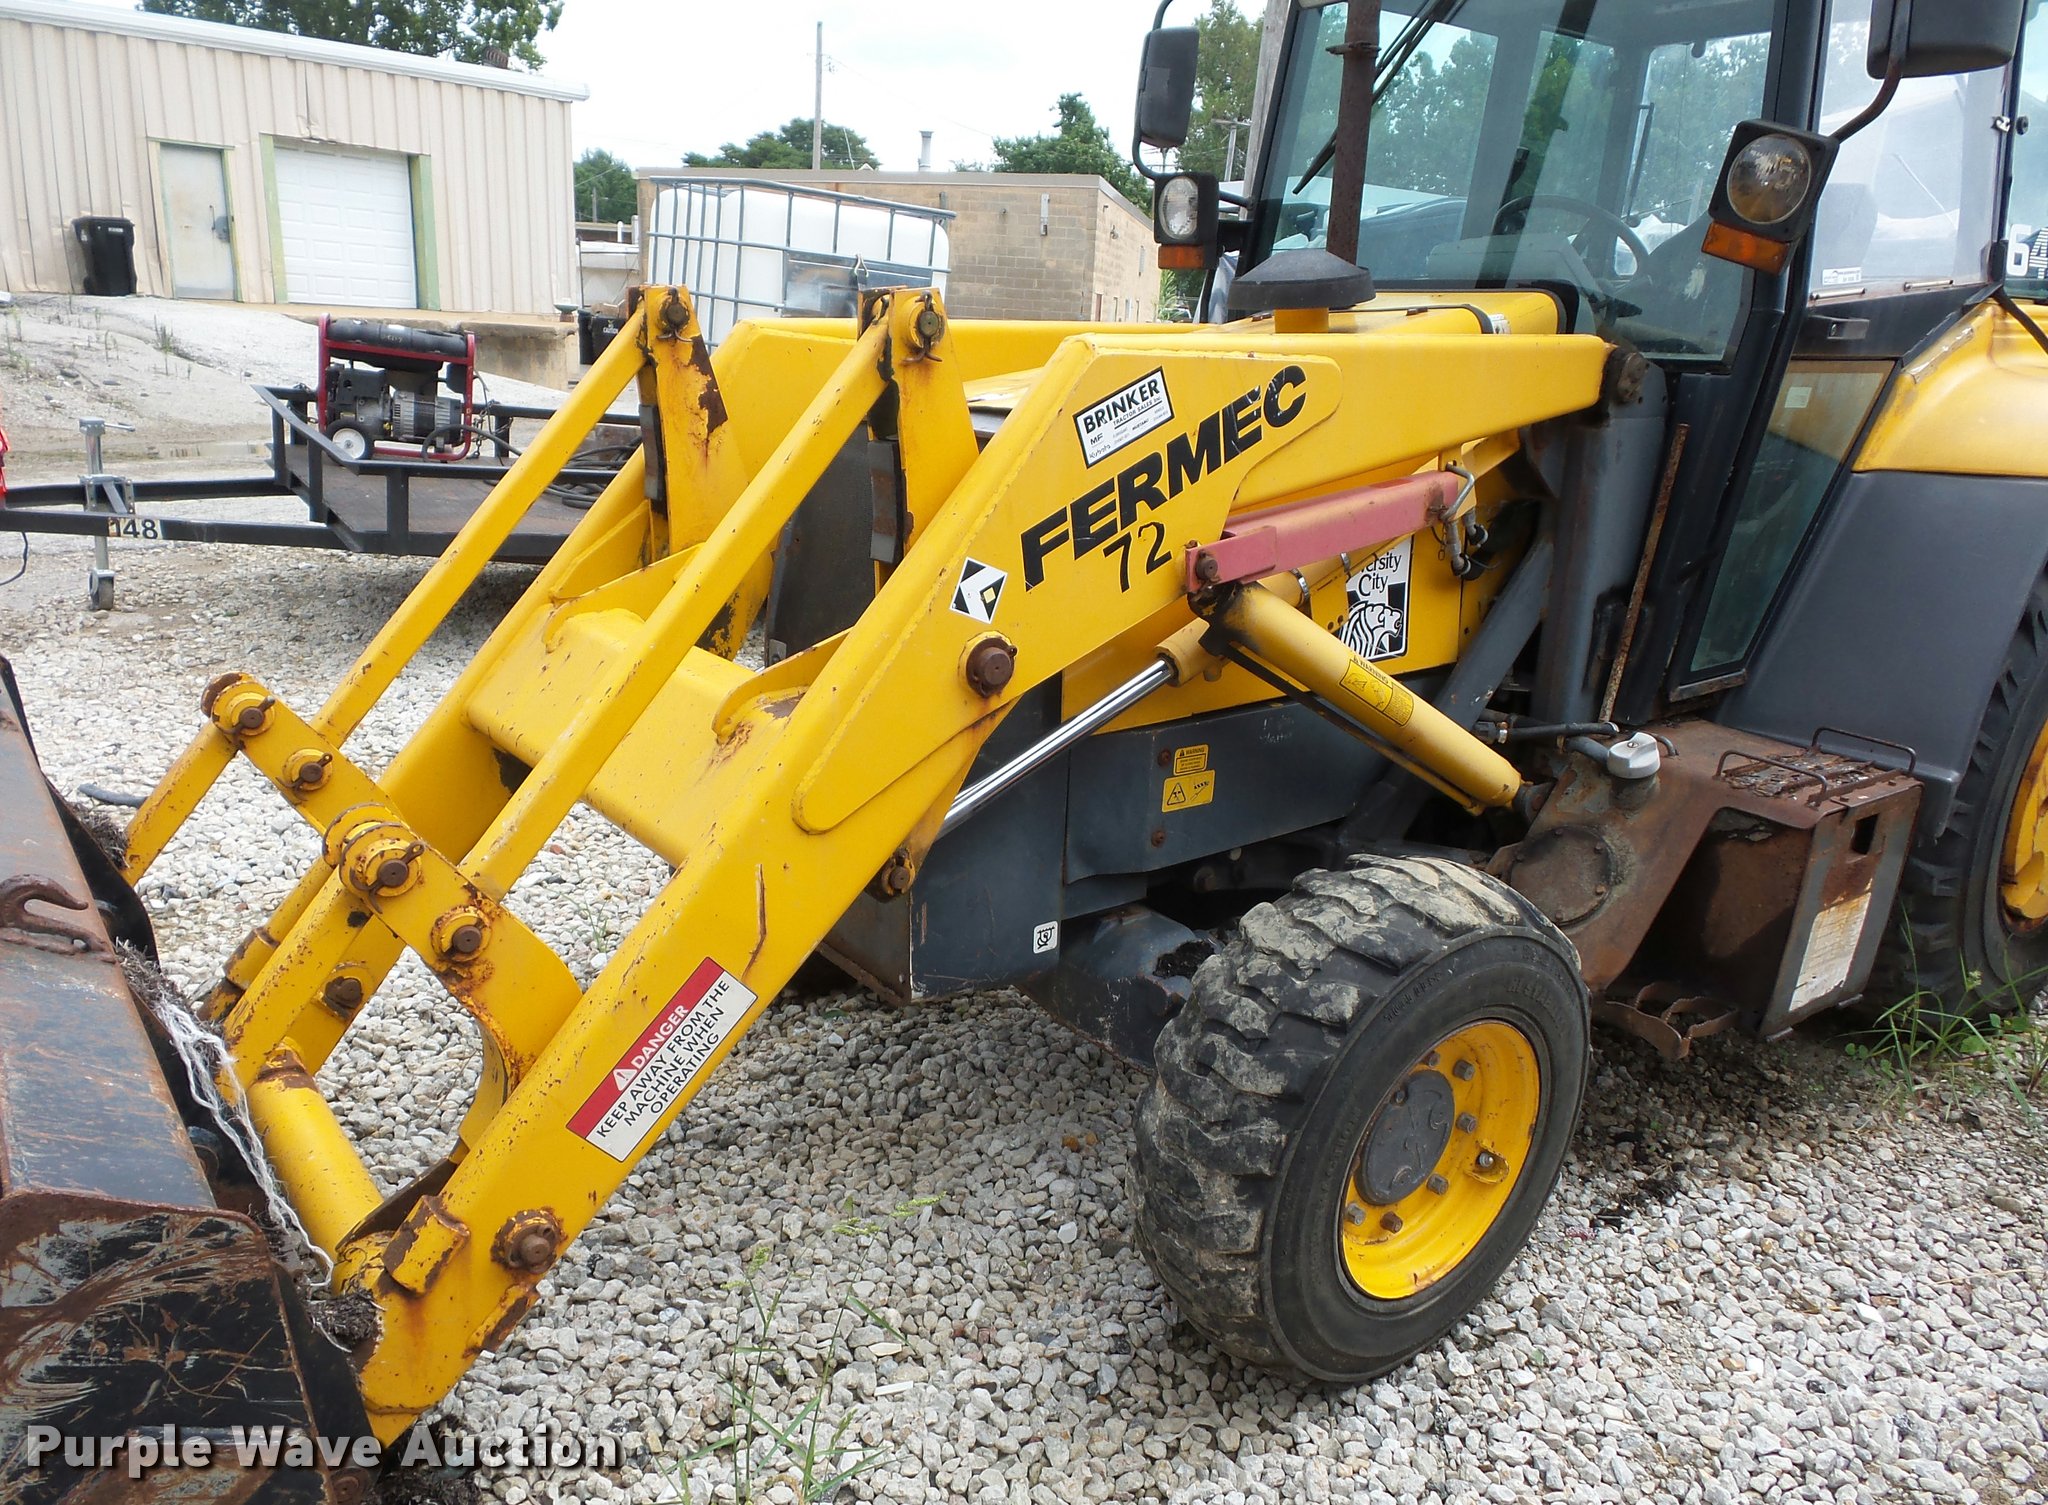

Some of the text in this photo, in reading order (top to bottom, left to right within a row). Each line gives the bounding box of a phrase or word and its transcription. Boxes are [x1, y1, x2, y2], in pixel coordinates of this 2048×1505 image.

[1083, 378, 1160, 434] BRINKER
[1090, 432, 1104, 446] MF
[1113, 410, 1137, 427] TRACTOR
[1137, 401, 1153, 413] SALES
[1021, 365, 1307, 592] FERMEC
[109, 518, 158, 540] 148
[1102, 521, 1173, 594] 72
[1358, 572, 1389, 597] City
[596, 980, 730, 1138] KEEP AWAY FROM THE
[623, 1007, 725, 1127] MACHINE WHEN
[630, 1004, 690, 1070] DANGER
[650, 1033, 719, 1114] OPERATING
